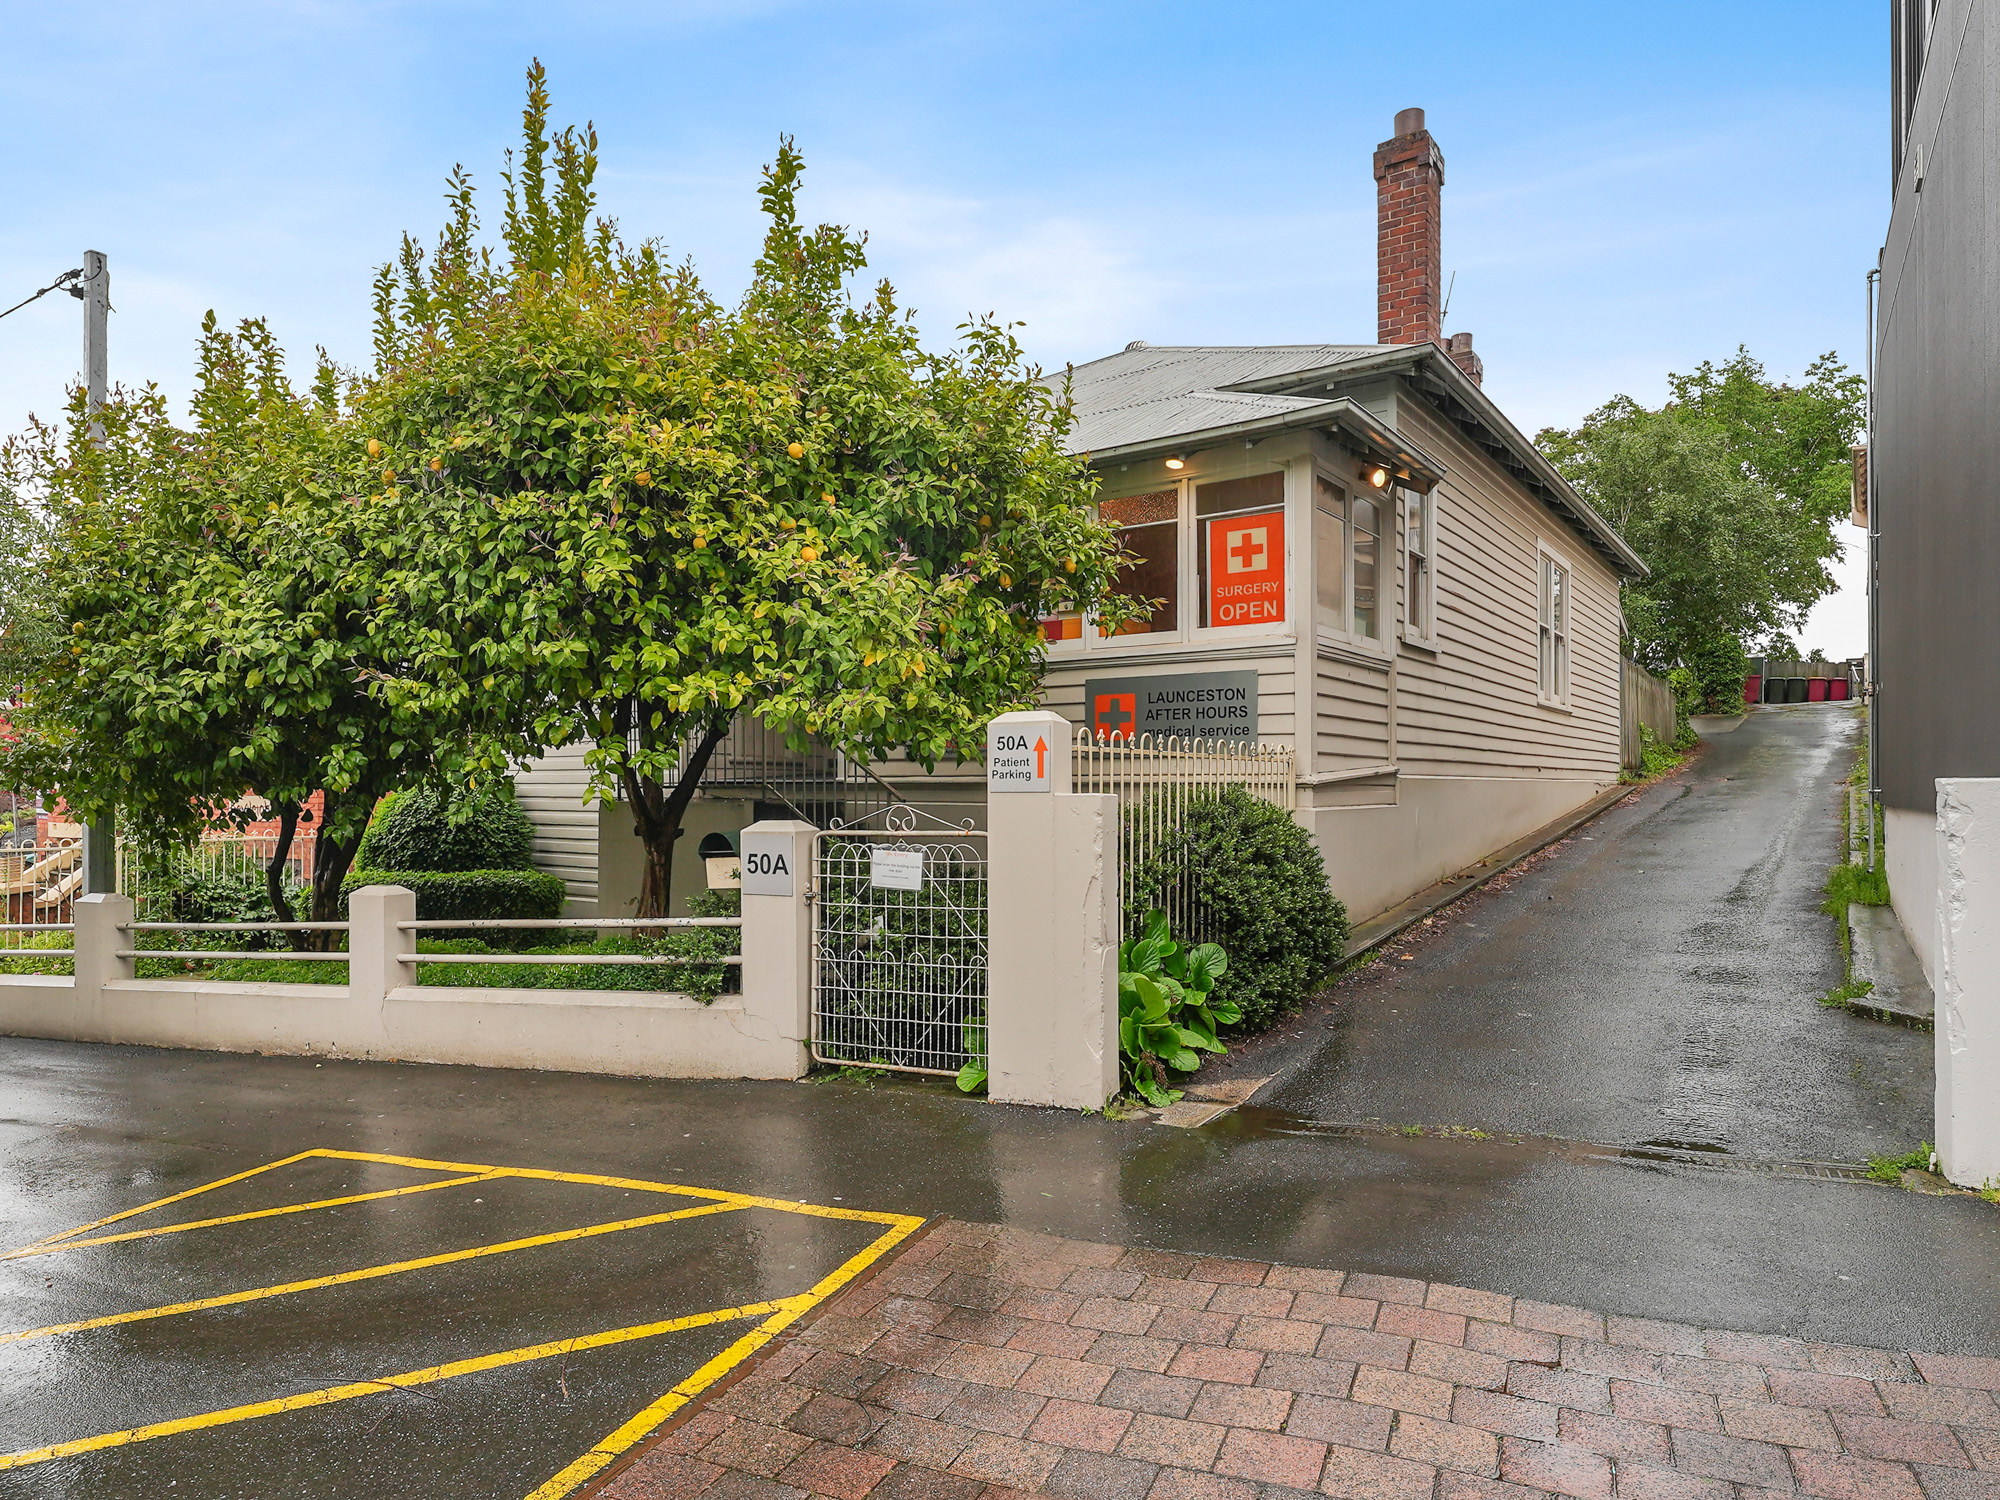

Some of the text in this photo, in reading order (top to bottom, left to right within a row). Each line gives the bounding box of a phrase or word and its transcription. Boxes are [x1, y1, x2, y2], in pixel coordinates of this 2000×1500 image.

[1216, 581, 1279, 598] SURGERY
[1219, 600, 1277, 621] OPEN
[1148, 688, 1246, 704] LAUNCESTON
[1145, 705, 1248, 721] AFTER HOURS
[1144, 724, 1250, 737] medical service
[997, 735, 1028, 751] 50A
[993, 757, 1030, 767] Patient
[992, 769, 1031, 781] Parking
[747, 853, 789, 875] 50A
